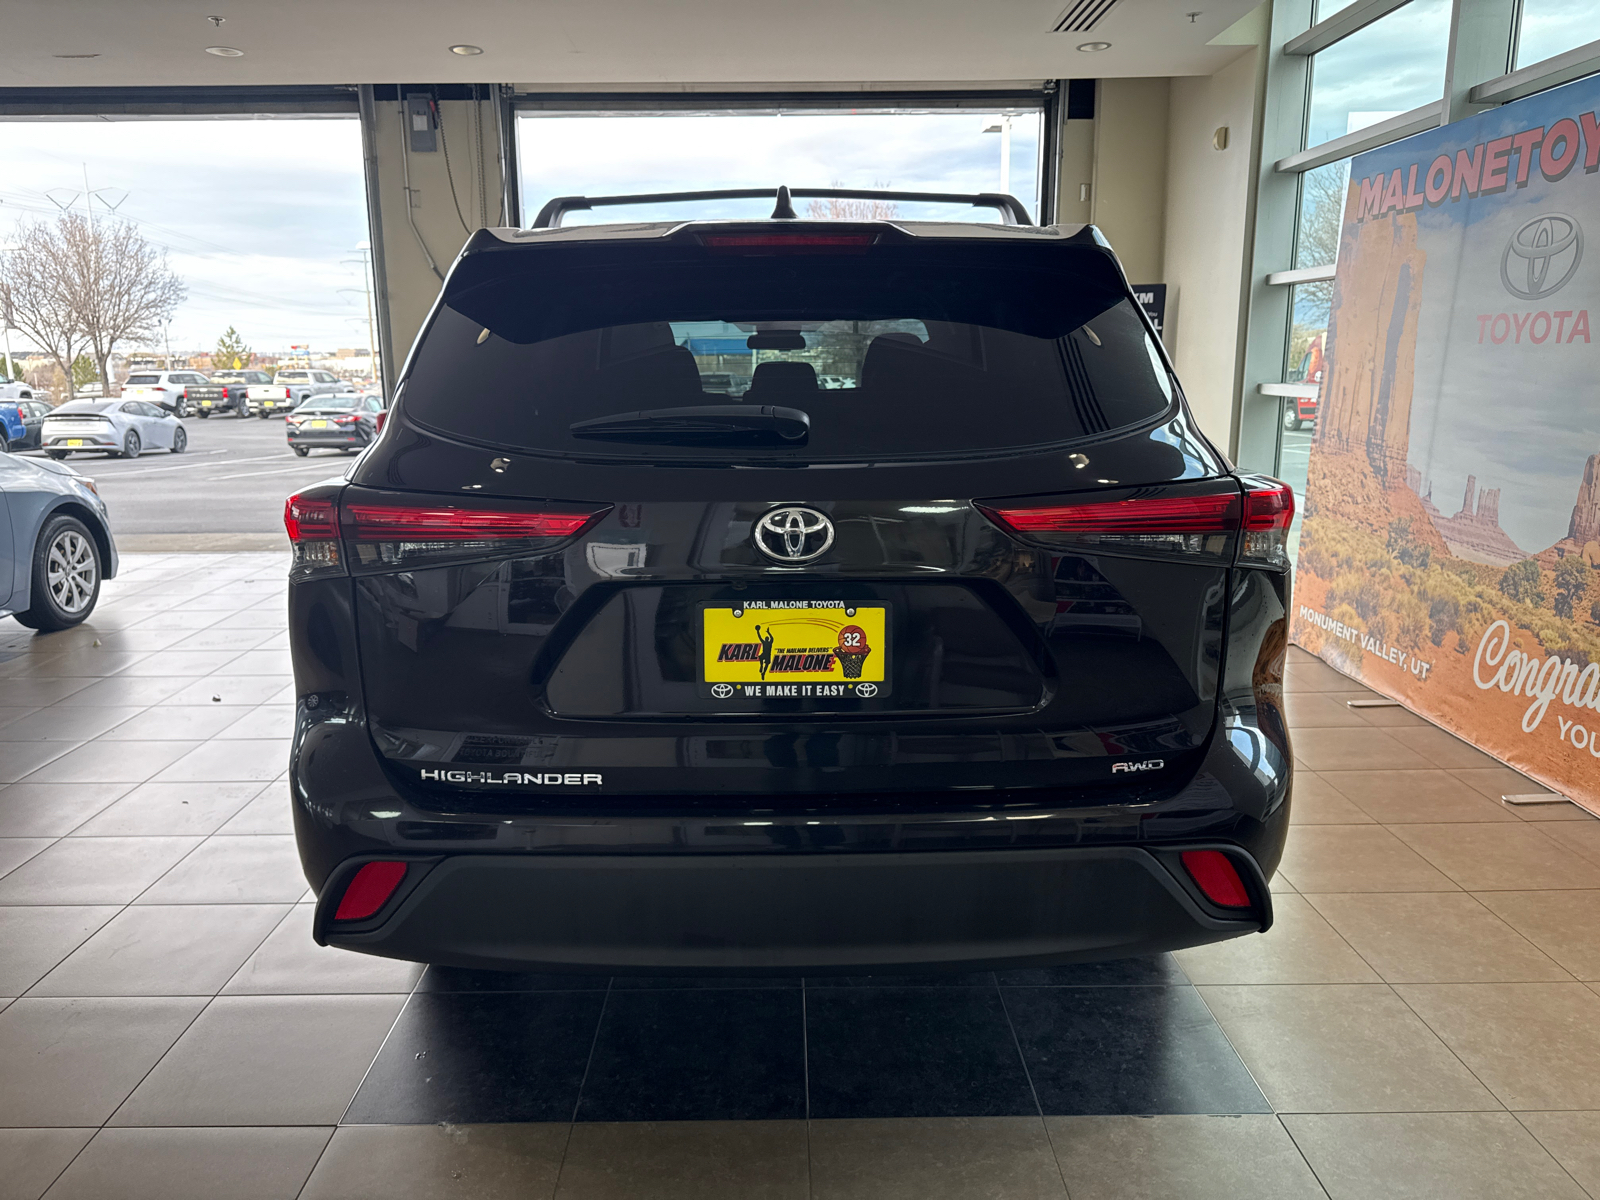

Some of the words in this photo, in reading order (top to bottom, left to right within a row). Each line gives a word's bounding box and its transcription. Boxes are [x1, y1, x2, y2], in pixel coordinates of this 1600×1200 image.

[1477, 310, 1591, 344] TOYOTA
[743, 601, 768, 609] KARL
[771, 601, 808, 609] MALONE
[810, 601, 845, 609] TOYOTA
[843, 632, 861, 647] 32
[1299, 604, 1358, 644] MONUMENT
[1360, 633, 1407, 672] VALLEY,
[1410, 657, 1430, 679] UT
[717, 643, 761, 662] KARL
[769, 653, 836, 673] MALONE
[744, 686, 762, 696] WE
[766, 685, 798, 696] MAKE
[802, 685, 812, 696] IT
[816, 685, 845, 696] EASY
[1112, 759, 1164, 774] AWD
[421, 769, 603, 785] HIGHLANDER
